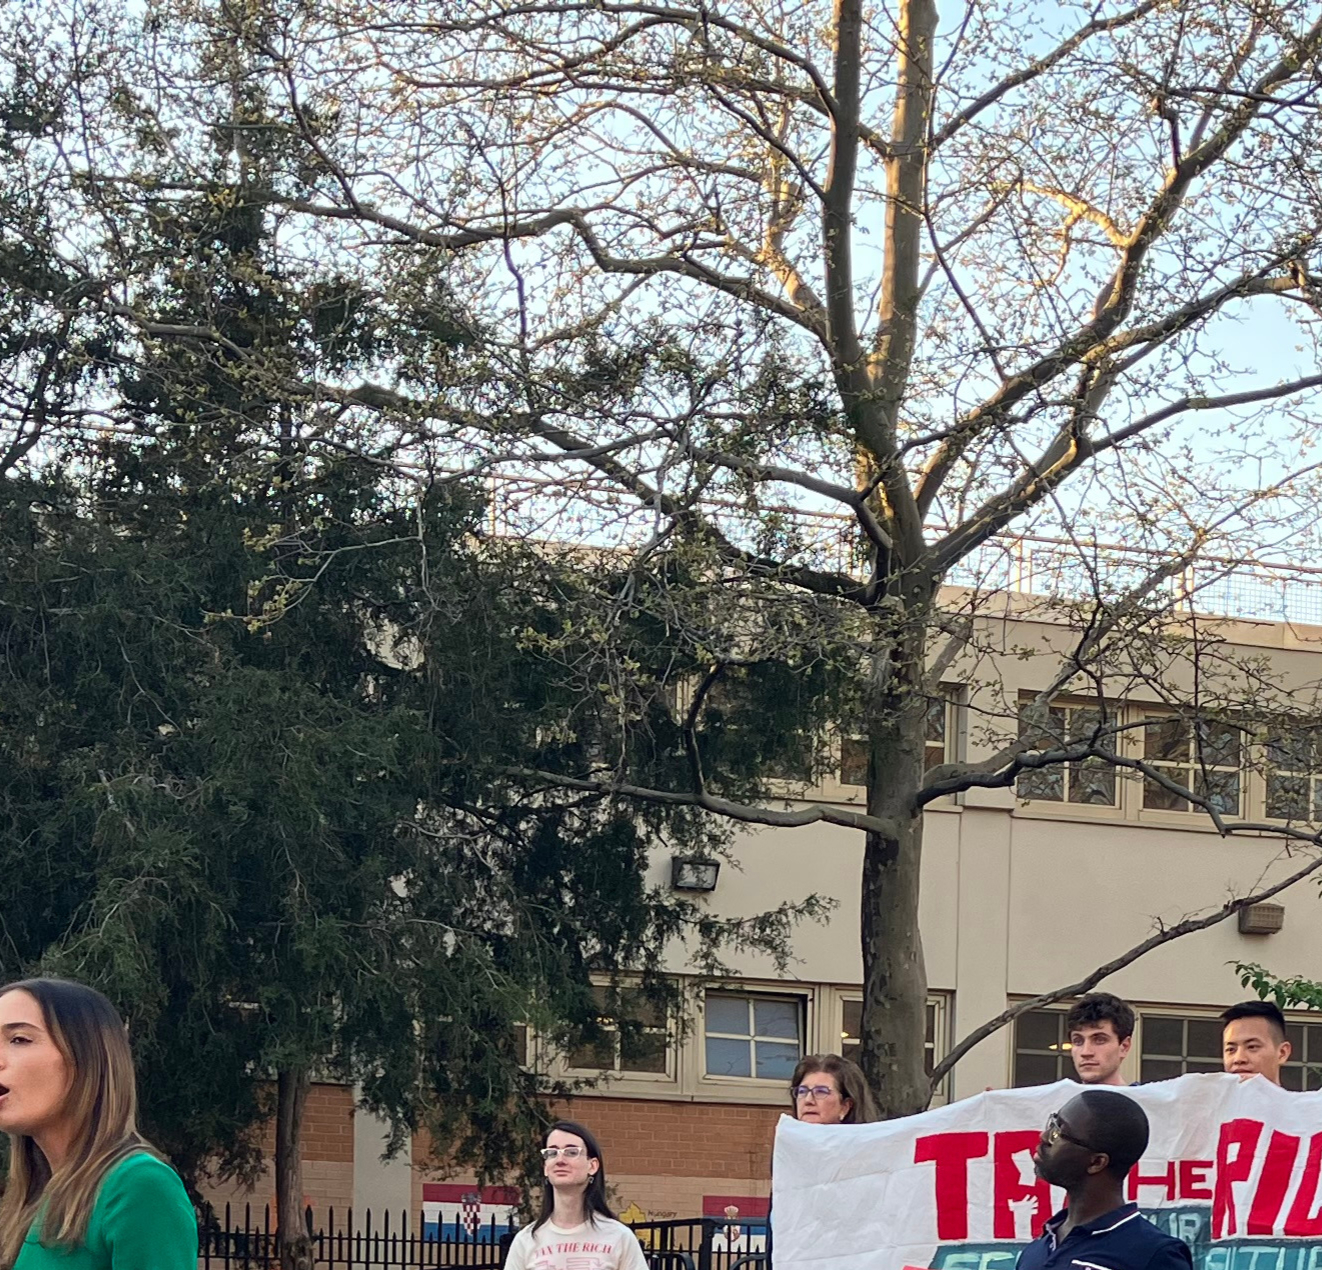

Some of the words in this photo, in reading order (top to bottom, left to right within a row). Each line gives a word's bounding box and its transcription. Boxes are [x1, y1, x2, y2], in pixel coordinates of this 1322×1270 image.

[1126, 1160, 1214, 1201] HE
[556, 1242, 580, 1253] THE
[582, 1241, 612, 1254] RICH
